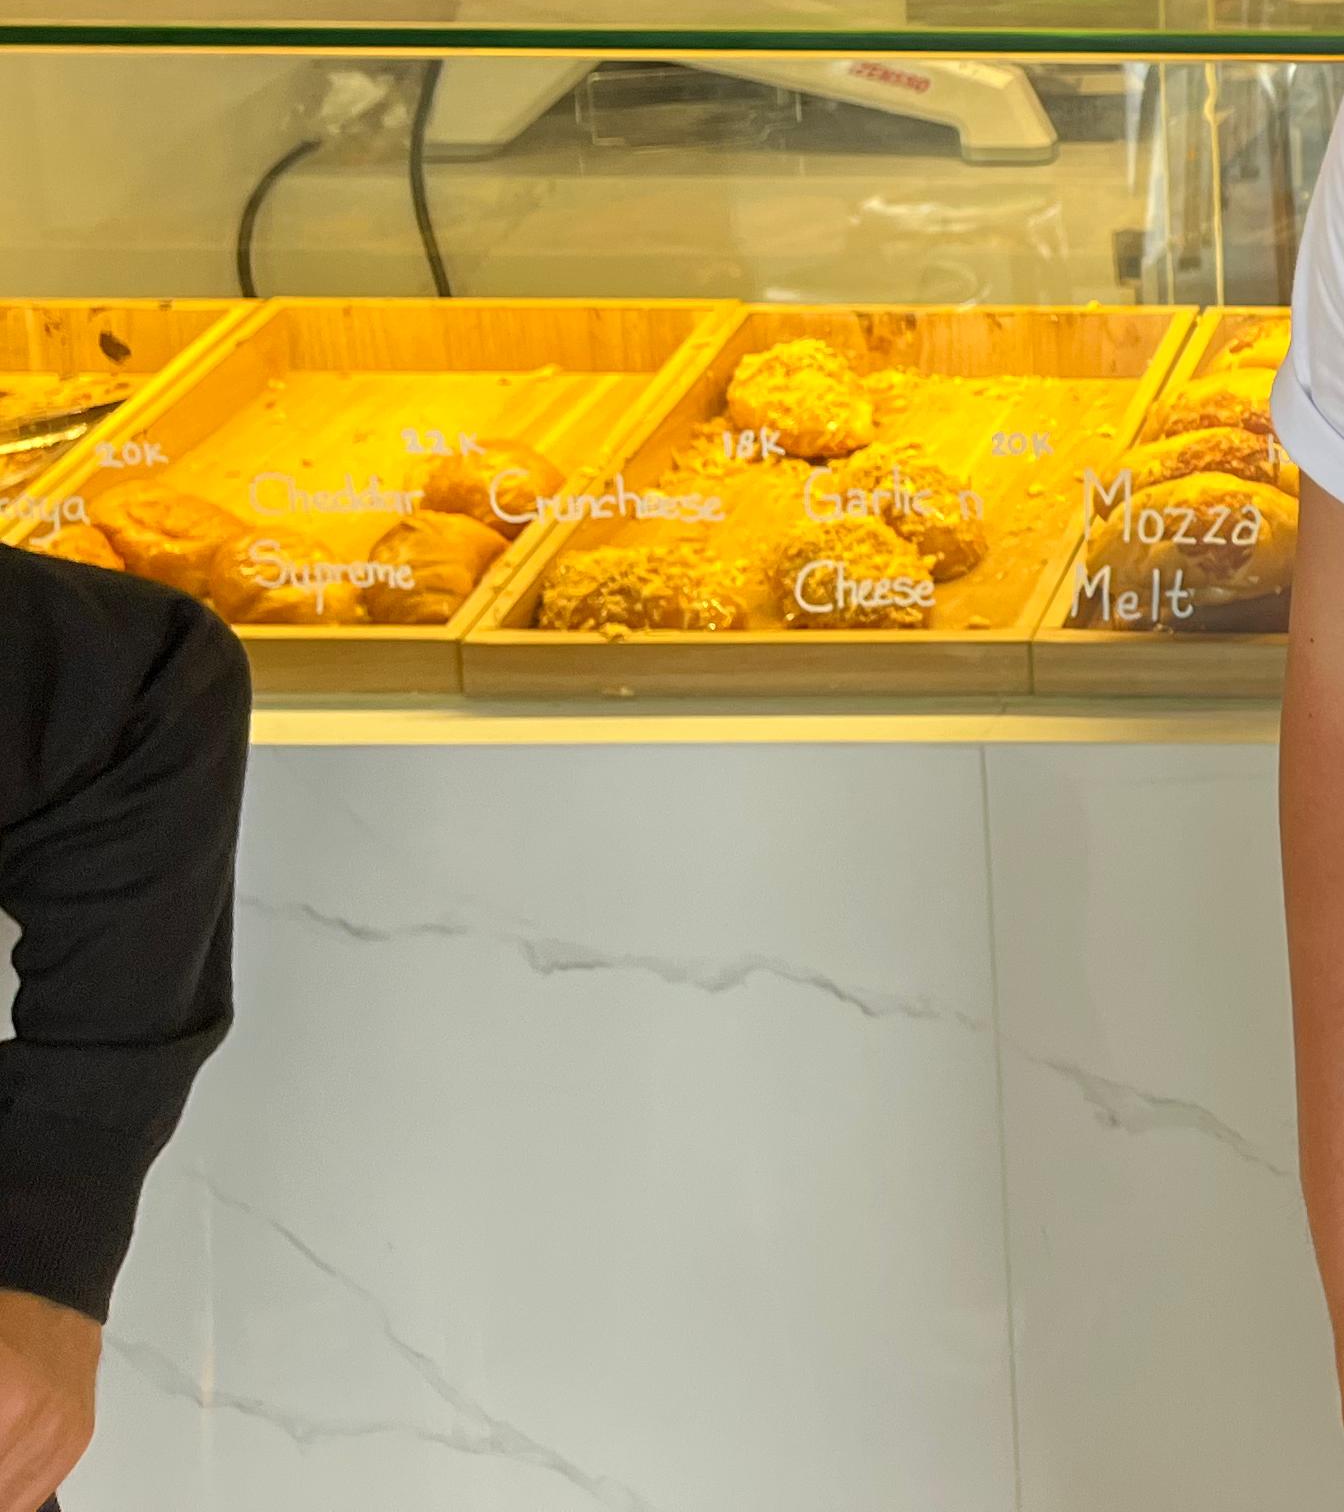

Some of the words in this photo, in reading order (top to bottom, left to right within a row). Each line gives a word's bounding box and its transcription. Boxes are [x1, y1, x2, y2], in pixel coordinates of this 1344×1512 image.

[96, 441, 169, 469] 20K
[401, 428, 485, 457] 22K
[721, 429, 787, 460] 18K
[991, 431, 1054, 457] 20K
[248, 471, 425, 519] Cheddar
[803, 465, 935, 524] Garlic
[957, 488, 985, 522] n
[1081, 467, 1262, 547] Mozza
[247, 538, 415, 614] Supreme
[794, 558, 937, 614] Cheese
[1070, 563, 1195, 621] Melt
